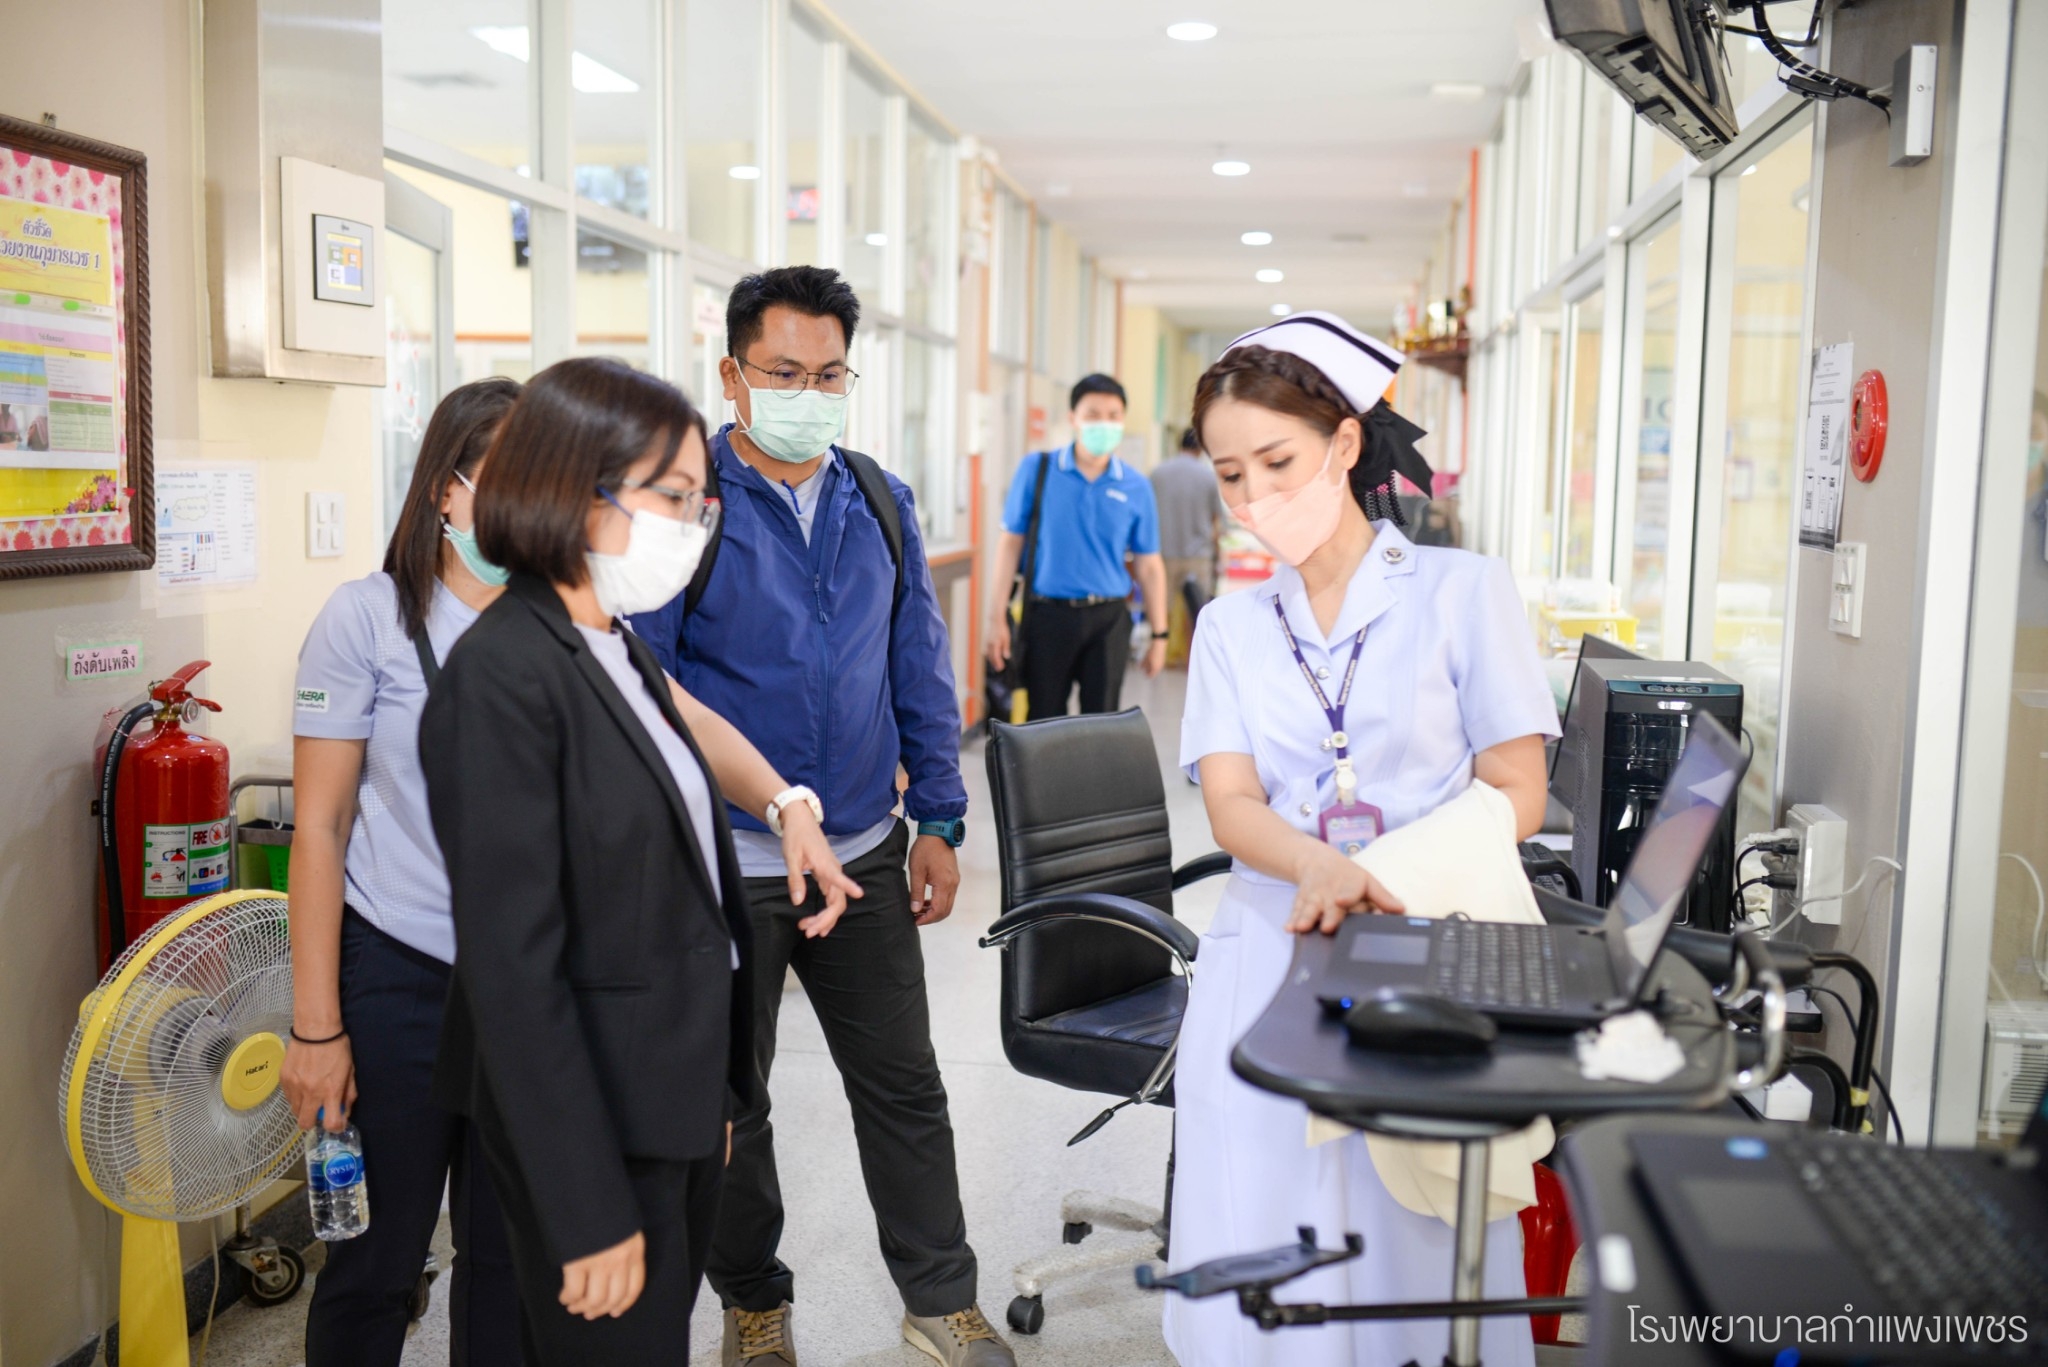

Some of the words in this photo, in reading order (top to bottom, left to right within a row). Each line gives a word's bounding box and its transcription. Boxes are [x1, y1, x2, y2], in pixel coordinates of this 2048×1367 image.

[74, 649, 135, 675] ถังดับเพลิง
[245, 1060, 268, 1076] Hatari
